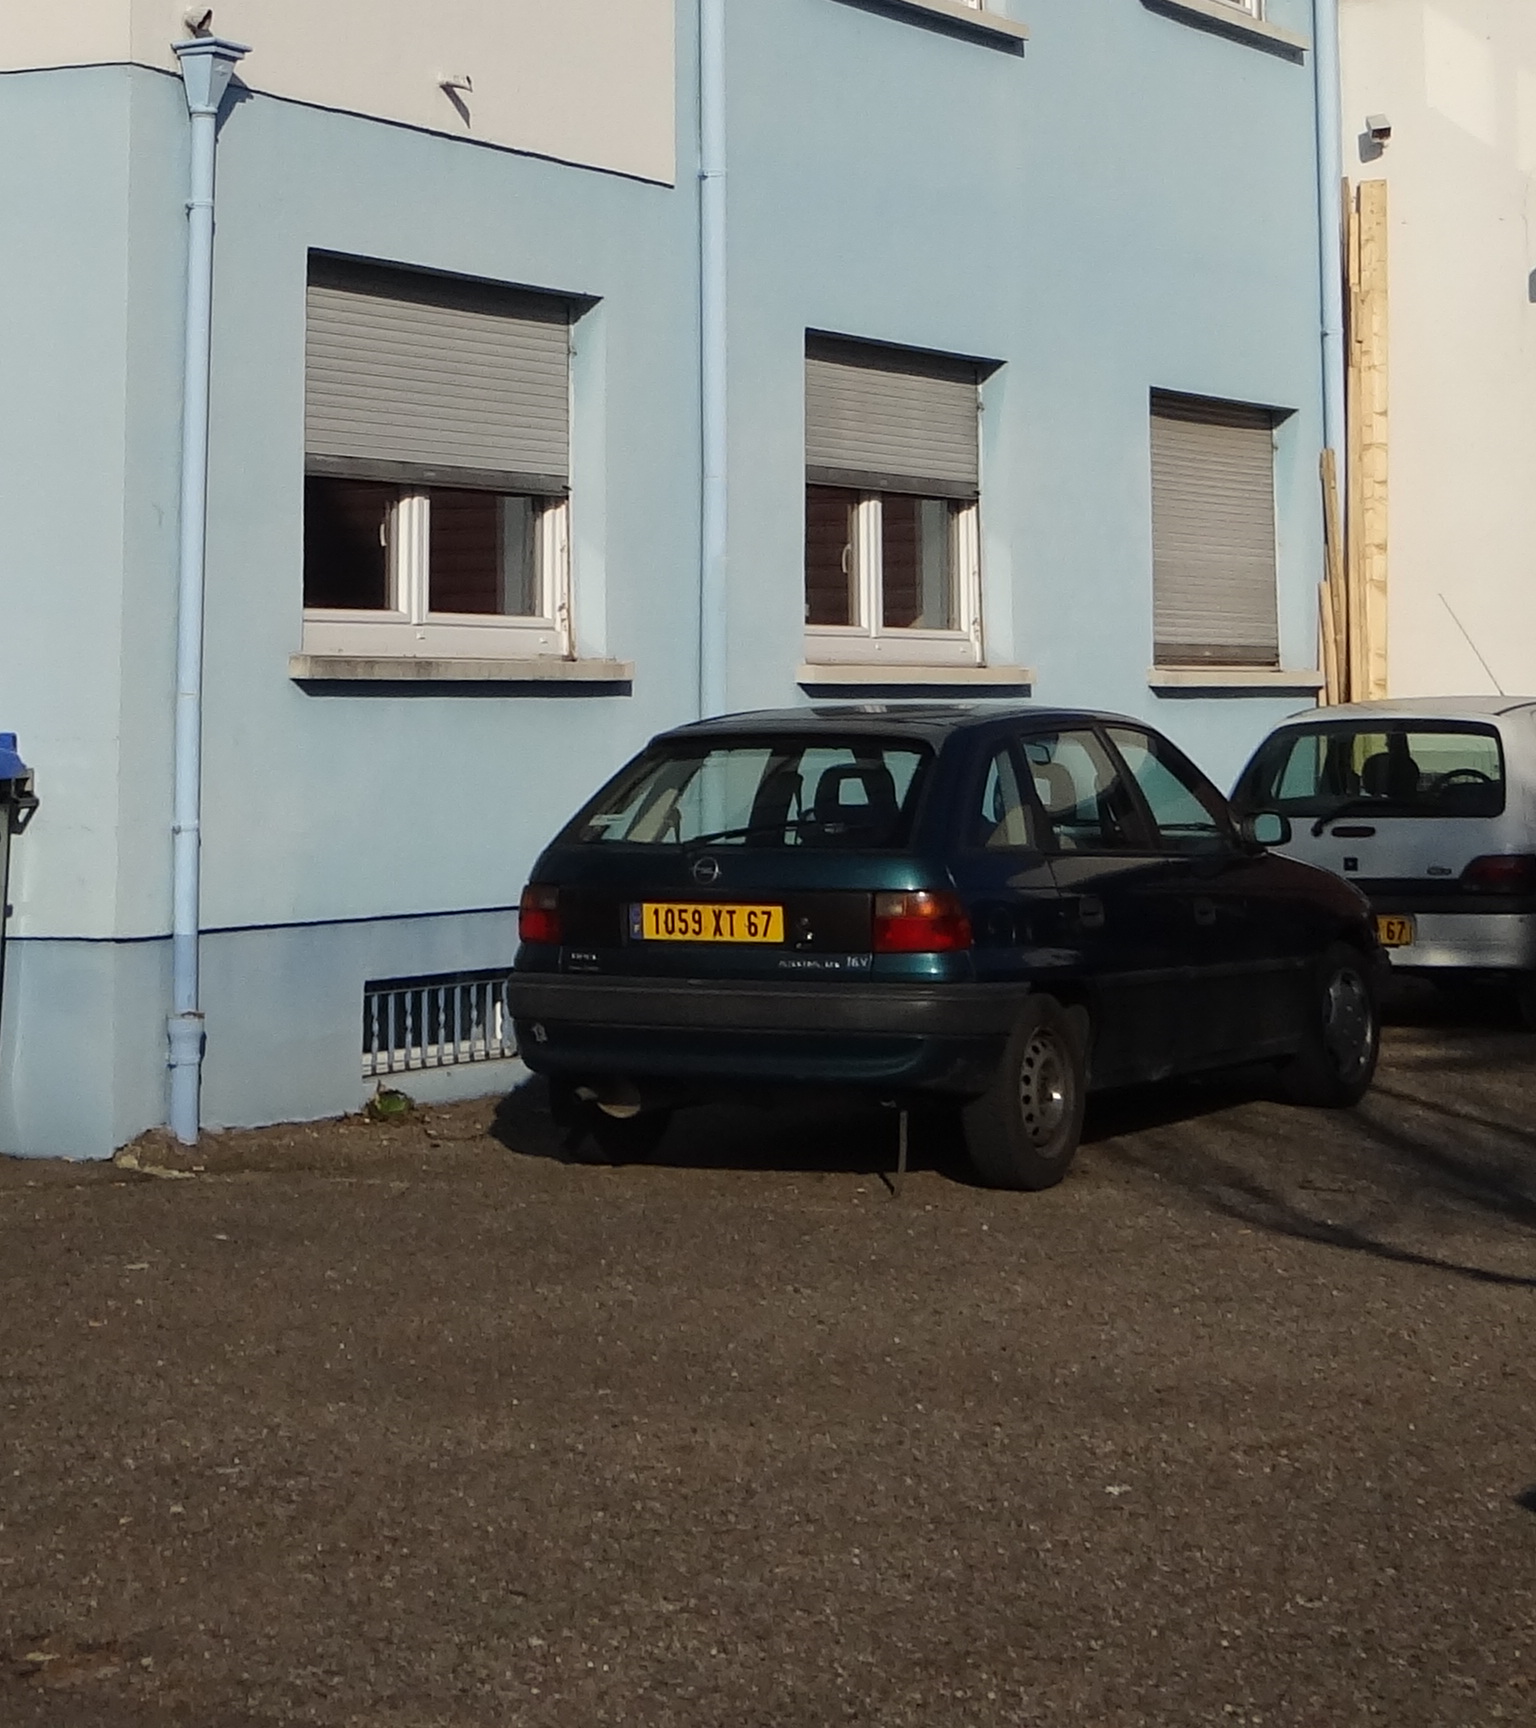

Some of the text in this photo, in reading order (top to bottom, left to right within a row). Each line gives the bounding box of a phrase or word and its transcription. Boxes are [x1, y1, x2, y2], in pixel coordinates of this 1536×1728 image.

[653, 907, 772, 938] 1059 XT 67
[1386, 921, 1406, 941] 67
